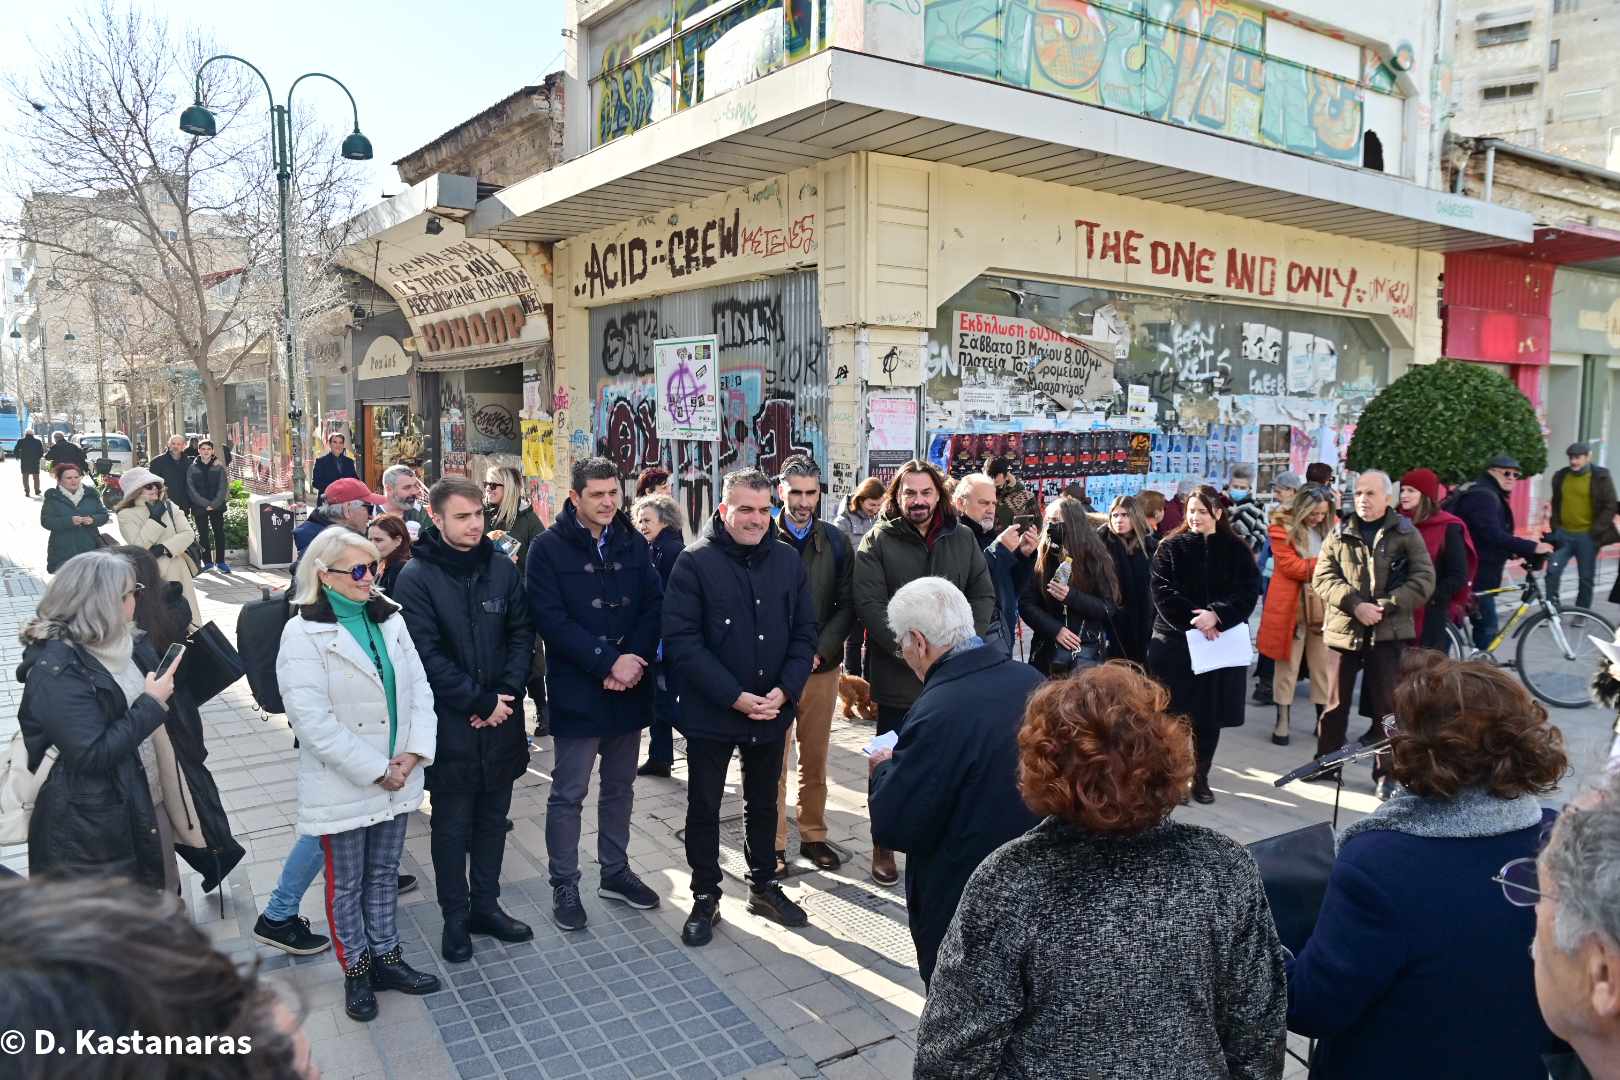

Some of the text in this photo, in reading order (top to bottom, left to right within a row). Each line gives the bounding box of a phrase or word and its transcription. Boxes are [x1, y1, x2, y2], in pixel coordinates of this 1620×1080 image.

[584, 208, 740, 299] ACID CREW
[1075, 219, 1144, 264] THE
[1225, 247, 1277, 297] AND
[1286, 261, 1358, 308] ONLY
[958, 352, 1006, 370] Πλατεία
[959, 333, 1013, 355] Σάββατο
[1016, 340, 1026, 356] 13
